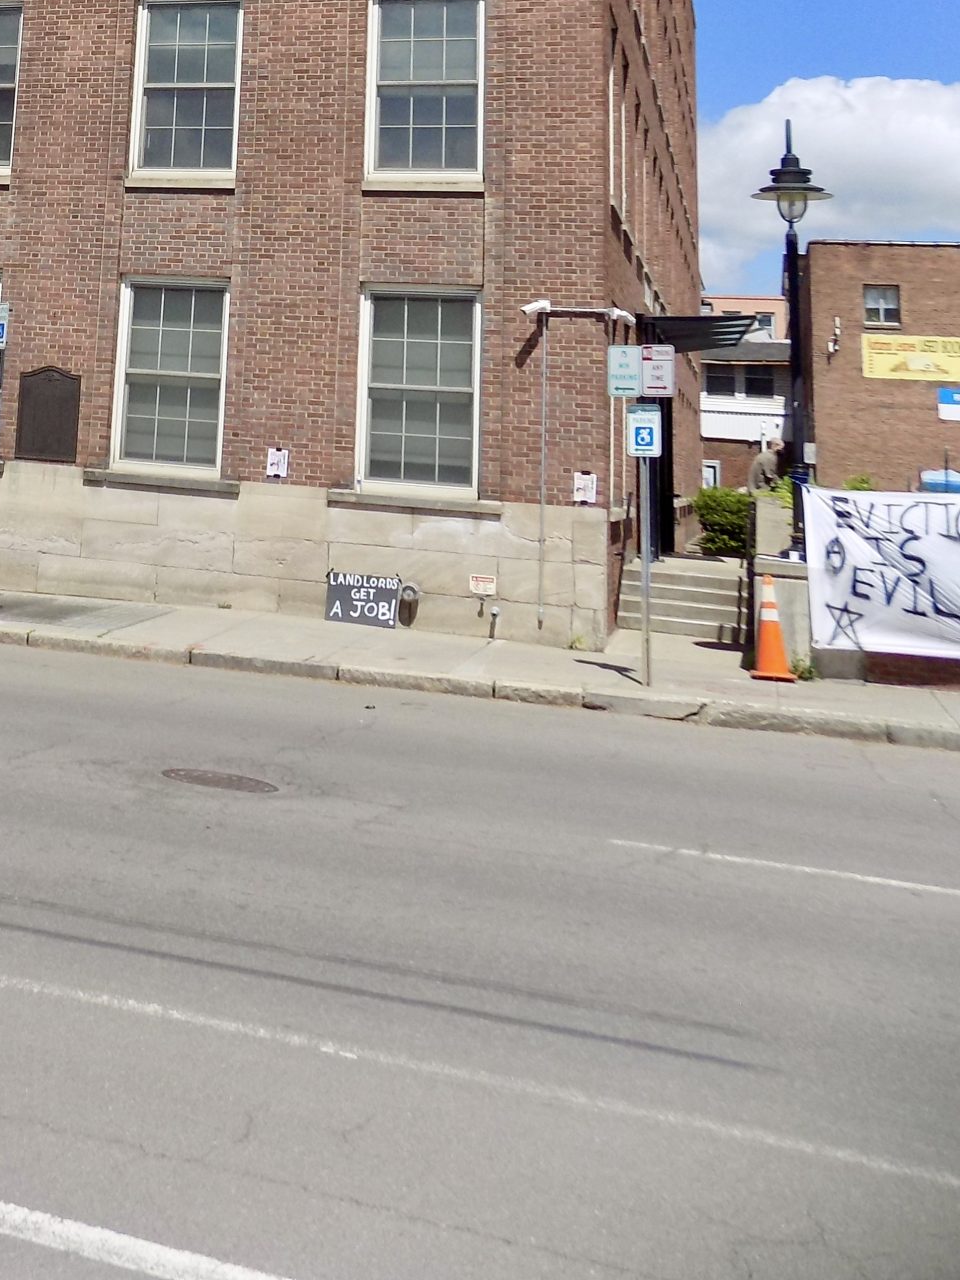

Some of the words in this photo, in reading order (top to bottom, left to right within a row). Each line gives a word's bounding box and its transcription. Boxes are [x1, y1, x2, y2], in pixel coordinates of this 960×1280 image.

[831, 496, 960, 540] EVICTI
[330, 572, 399, 589] LANDLORDS
[351, 588, 376, 600] GET
[329, 600, 342, 617] A
[350, 599, 396, 625] JOB!
